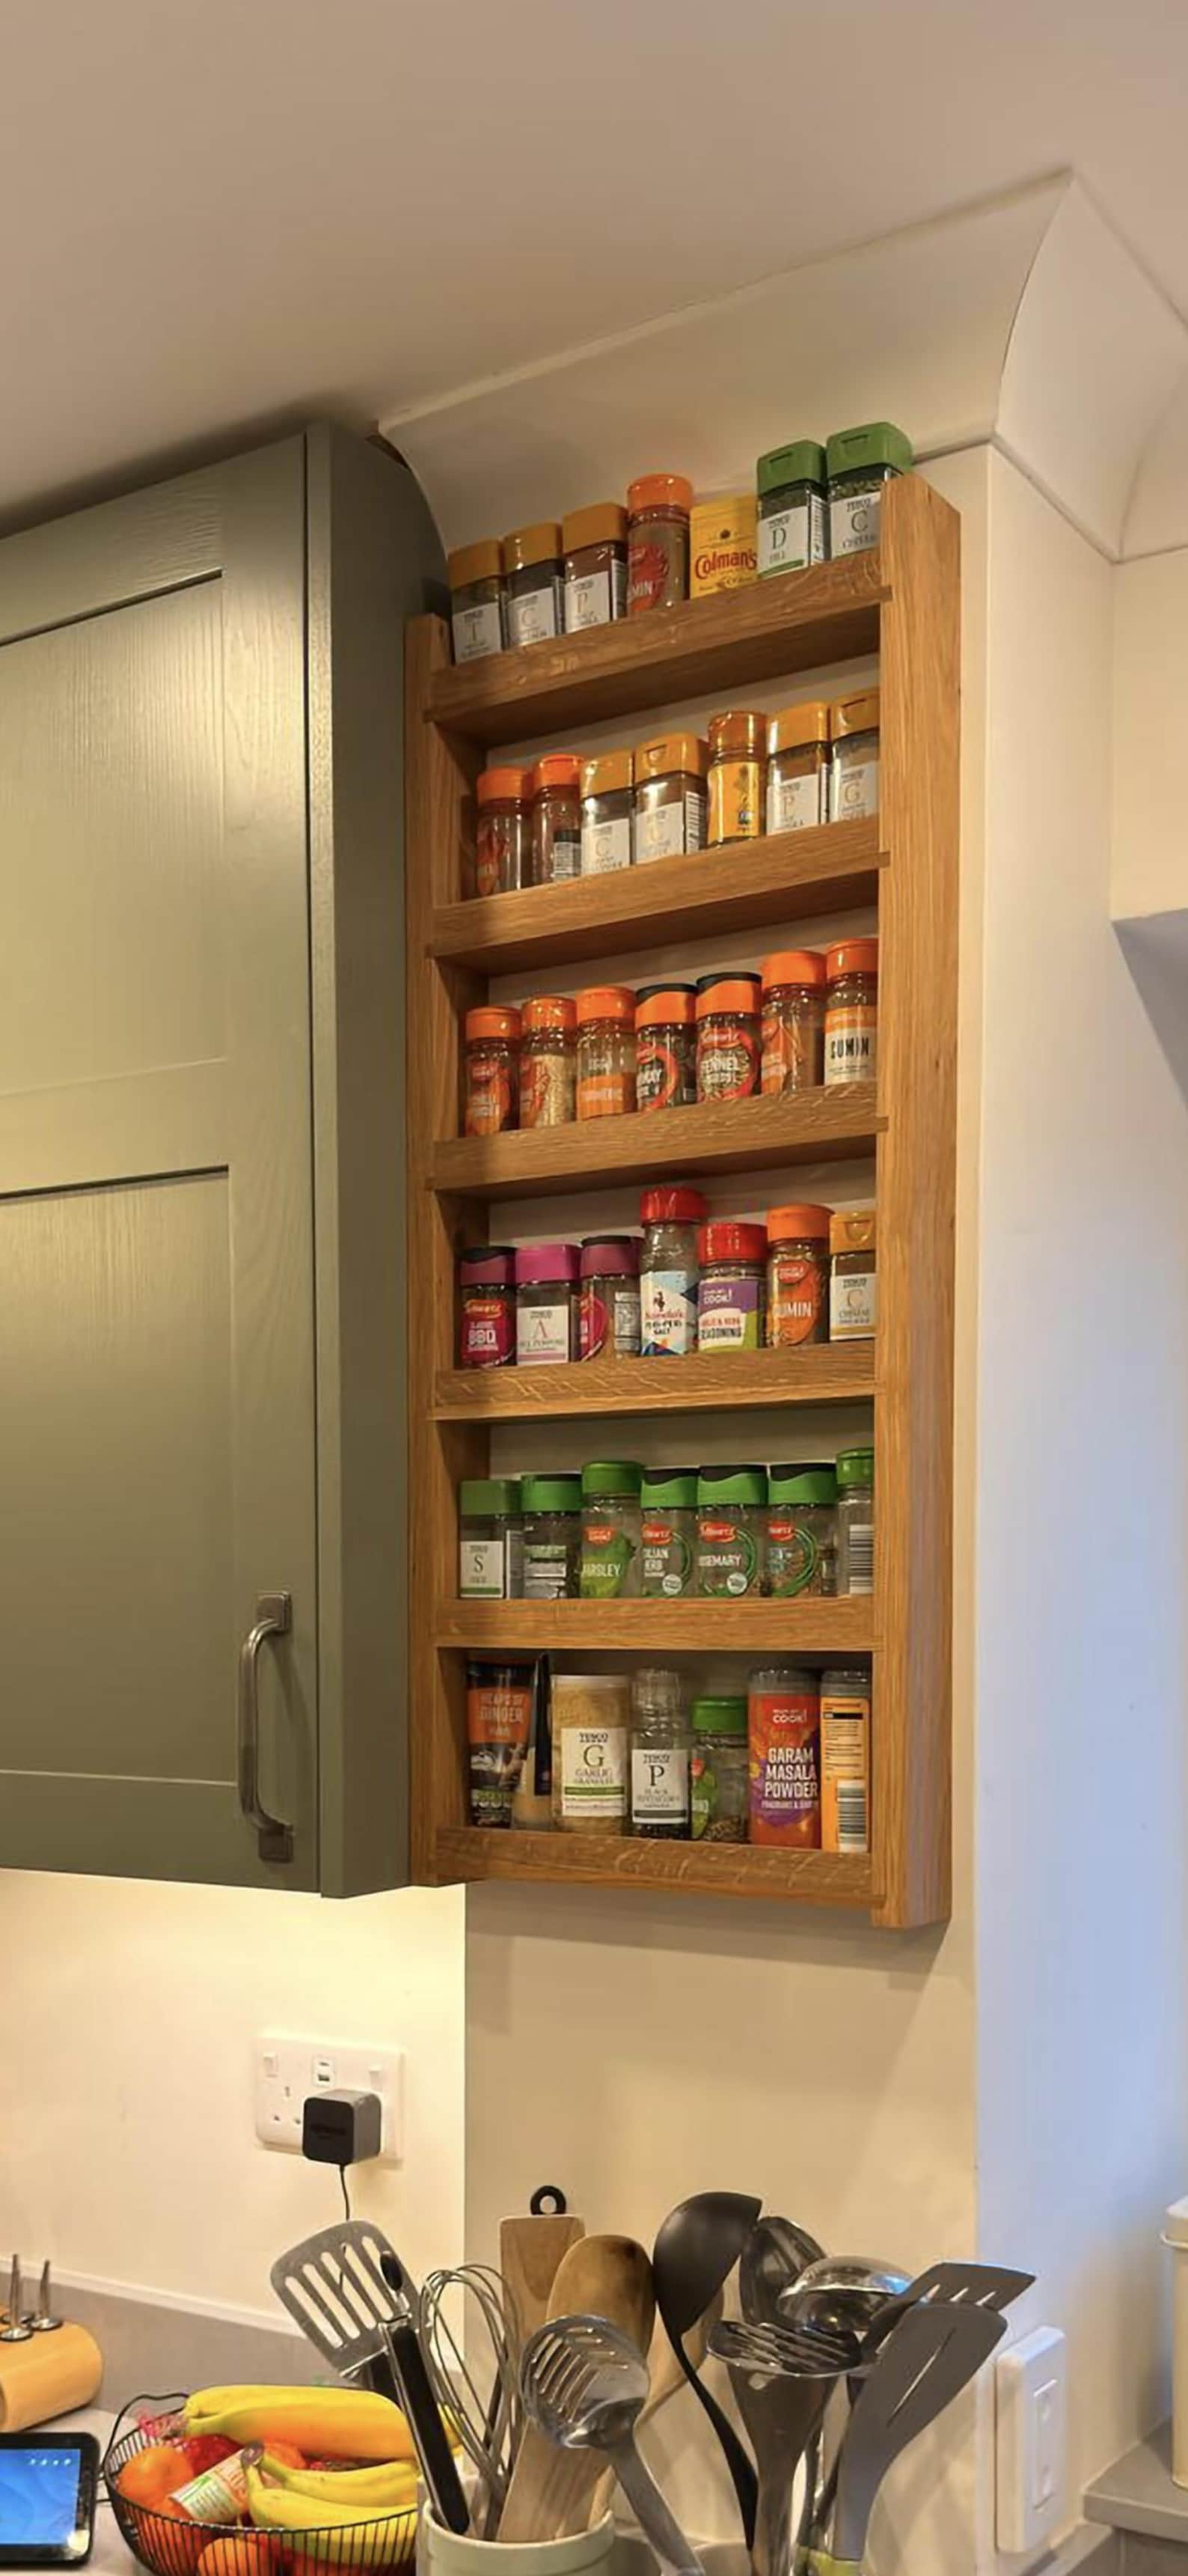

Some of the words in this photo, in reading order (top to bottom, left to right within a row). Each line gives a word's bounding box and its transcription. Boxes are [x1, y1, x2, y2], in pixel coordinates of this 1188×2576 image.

[851, 510, 869, 533] C
[772, 528, 786, 549] D
[695, 549, 757, 579] Colman's
[577, 591, 589, 613] P
[844, 782, 860, 802] G
[830, 1037, 869, 1059] CUMIN
[847, 1289, 864, 1310] C
[468, 1329, 497, 1345] BBQ
[533, 1319, 548, 1339] A
[474, 1554, 484, 1573] S
[583, 1745, 605, 1769] G
[768, 1748, 814, 1765] GARAM
[649, 1765, 665, 1787] P
[765, 1764, 818, 1781] MASALA
[765, 1781, 818, 1799] POWDER
